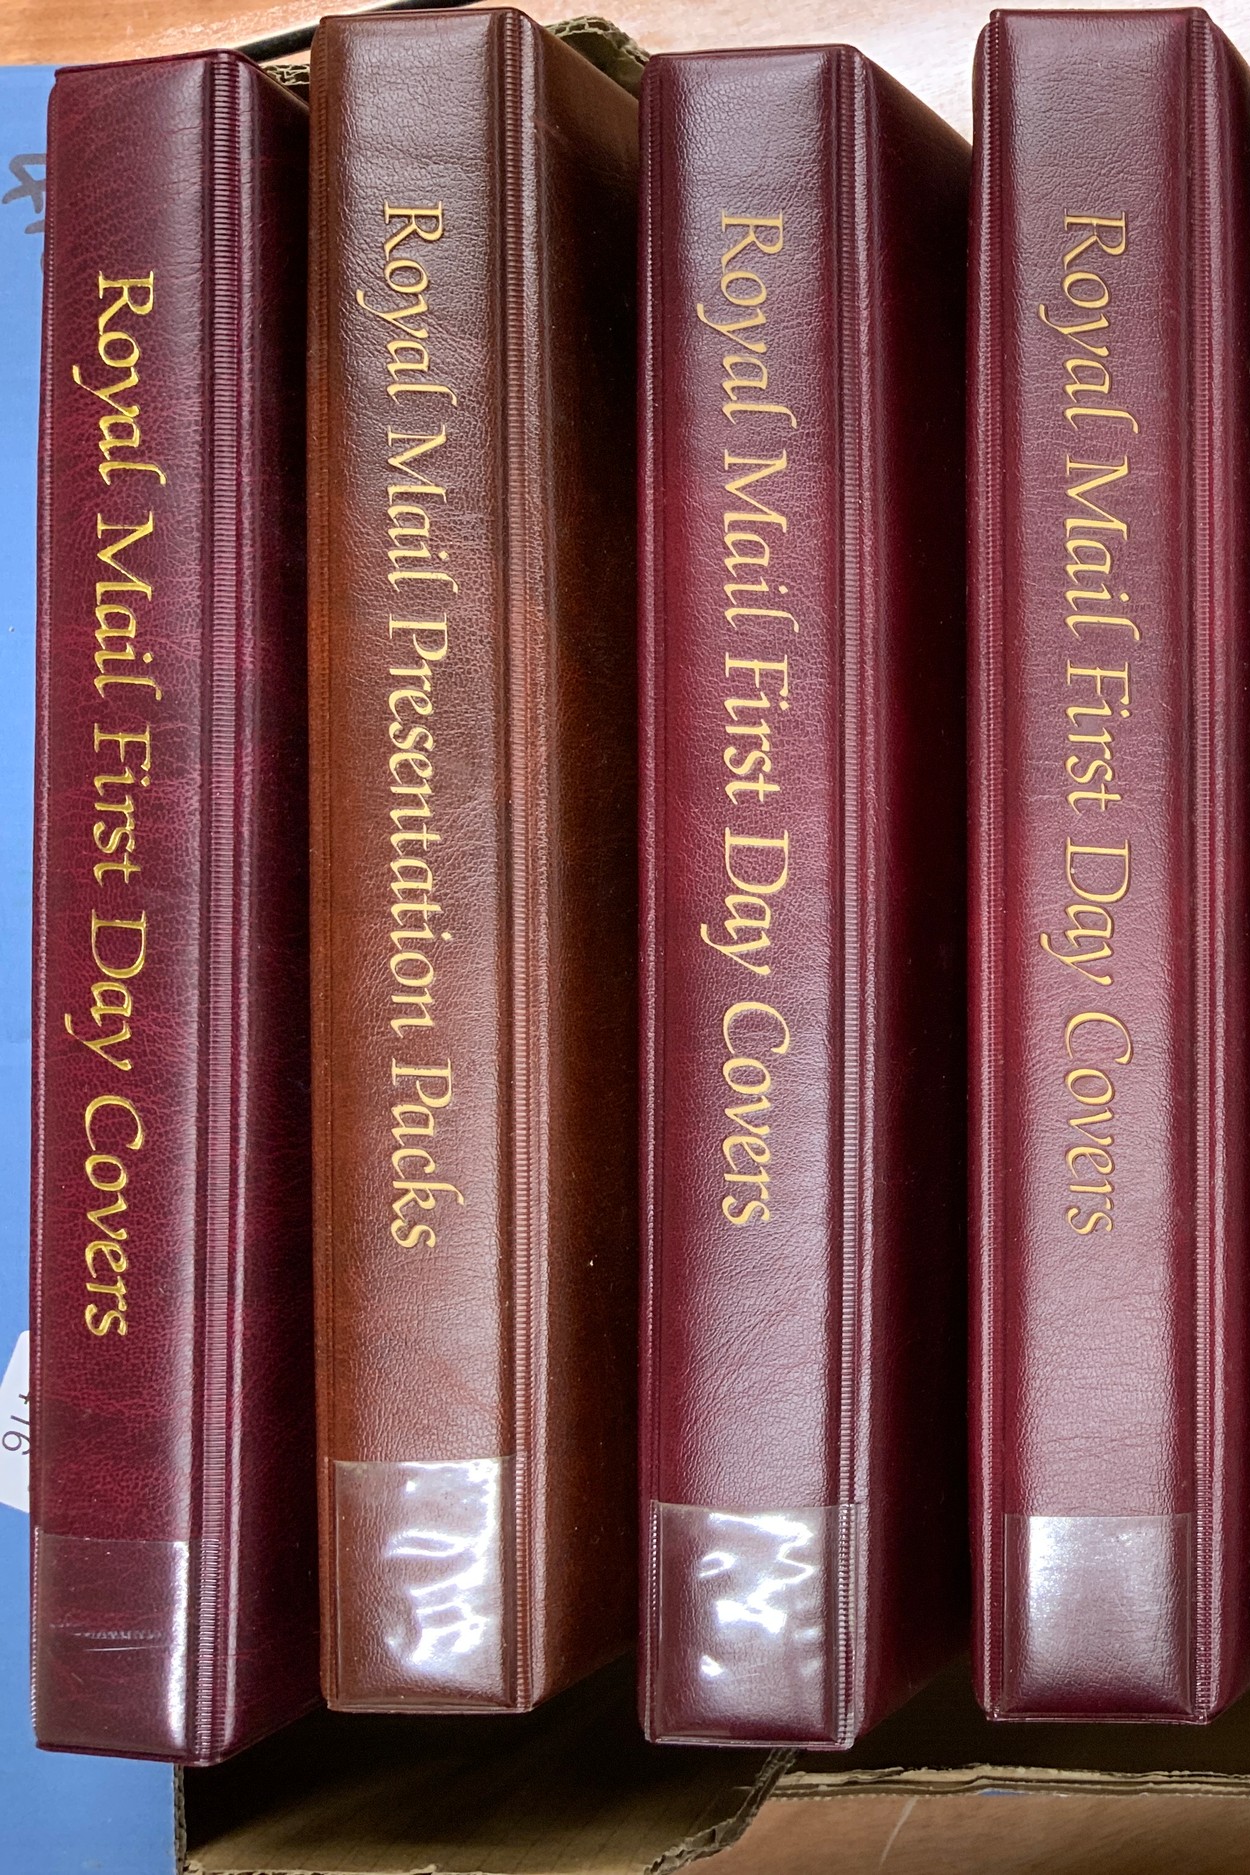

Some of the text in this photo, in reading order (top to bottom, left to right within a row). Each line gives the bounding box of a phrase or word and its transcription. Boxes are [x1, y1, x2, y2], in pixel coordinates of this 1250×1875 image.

[64, 270, 167, 1337] Royal Mail First Day Covers
[356, 201, 464, 1250] Royal Mail Presentation Packs
[697, 210, 800, 1226] Royal Mail First Day Covers
[1038, 208, 1141, 1236] Royal Mail First Day Covers
